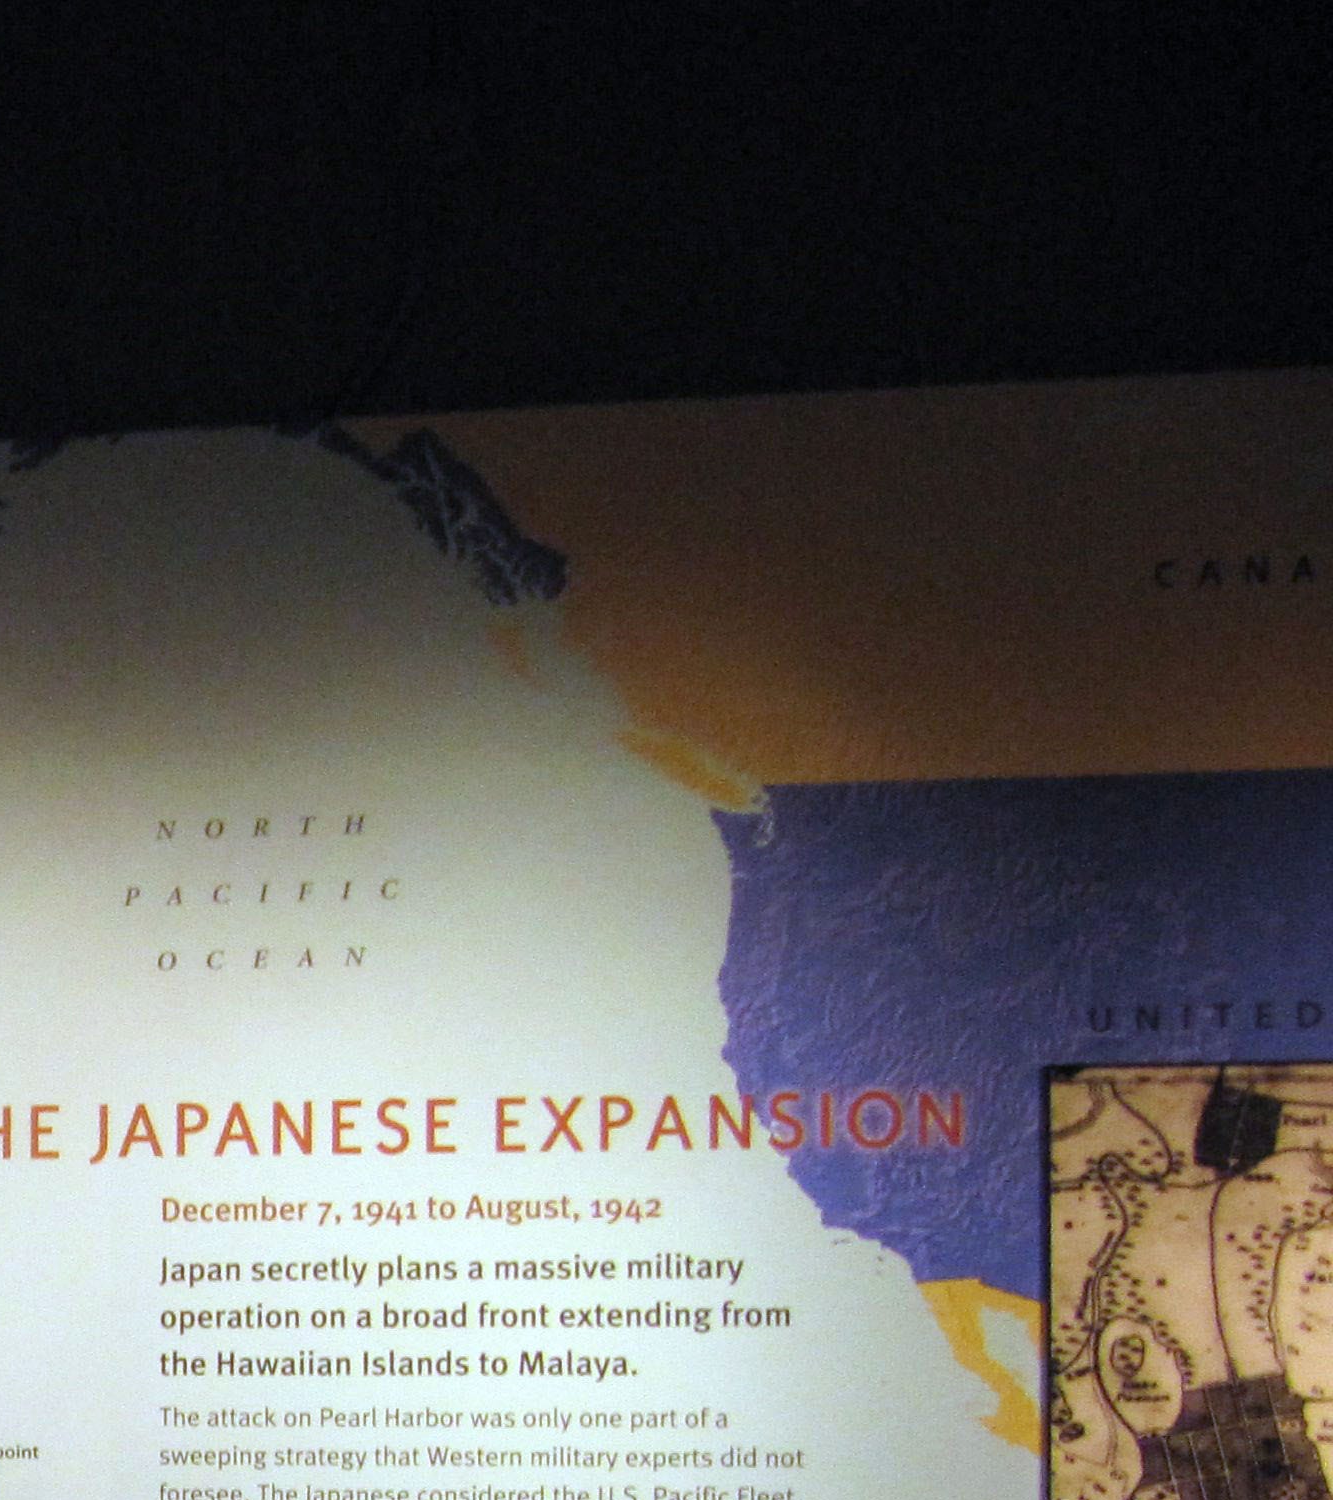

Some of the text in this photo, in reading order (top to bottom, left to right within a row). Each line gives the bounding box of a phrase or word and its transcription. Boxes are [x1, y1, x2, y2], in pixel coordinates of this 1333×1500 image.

[156, 812, 367, 841] NORTH
[124, 877, 400, 908] PACIFIC
[156, 945, 367, 972] OCEAN
[89, 1097, 456, 1164] JAPANESE
[493, 1089, 961, 1155] EXPANSION
[161, 1194, 662, 1227] December 7, 1941 to August, 1942
[159, 1252, 744, 1289] Japan secretly plans a massive military
[159, 1300, 791, 1336] operation on a broad front extending from
[159, 1349, 638, 1383] the Hawaiian Islands to Malaya.
[159, 1406, 729, 1434] The attack on Pearl Harbor was only one part of a
[159, 1445, 805, 1473] sweeping strategy that Western military experts did not
